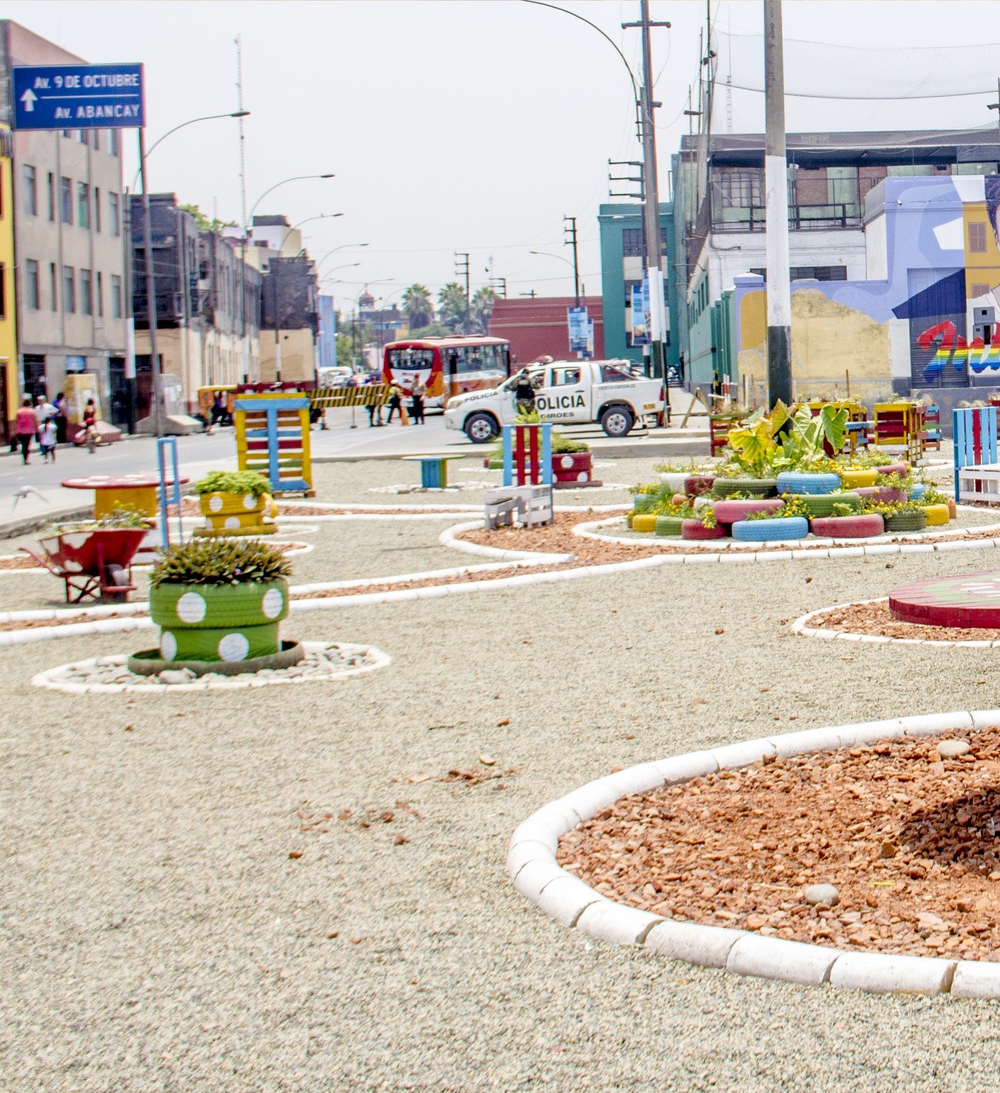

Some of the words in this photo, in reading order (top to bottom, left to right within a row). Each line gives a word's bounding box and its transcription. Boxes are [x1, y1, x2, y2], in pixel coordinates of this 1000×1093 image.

[53, 75, 63, 88] 9
[65, 75, 81, 88] DE
[82, 73, 140, 88] OCTUBRE
[76, 104, 140, 118] ABANCAY
[464, 391, 499, 403] POLICIA
[536, 395, 586, 410] OLICIA
